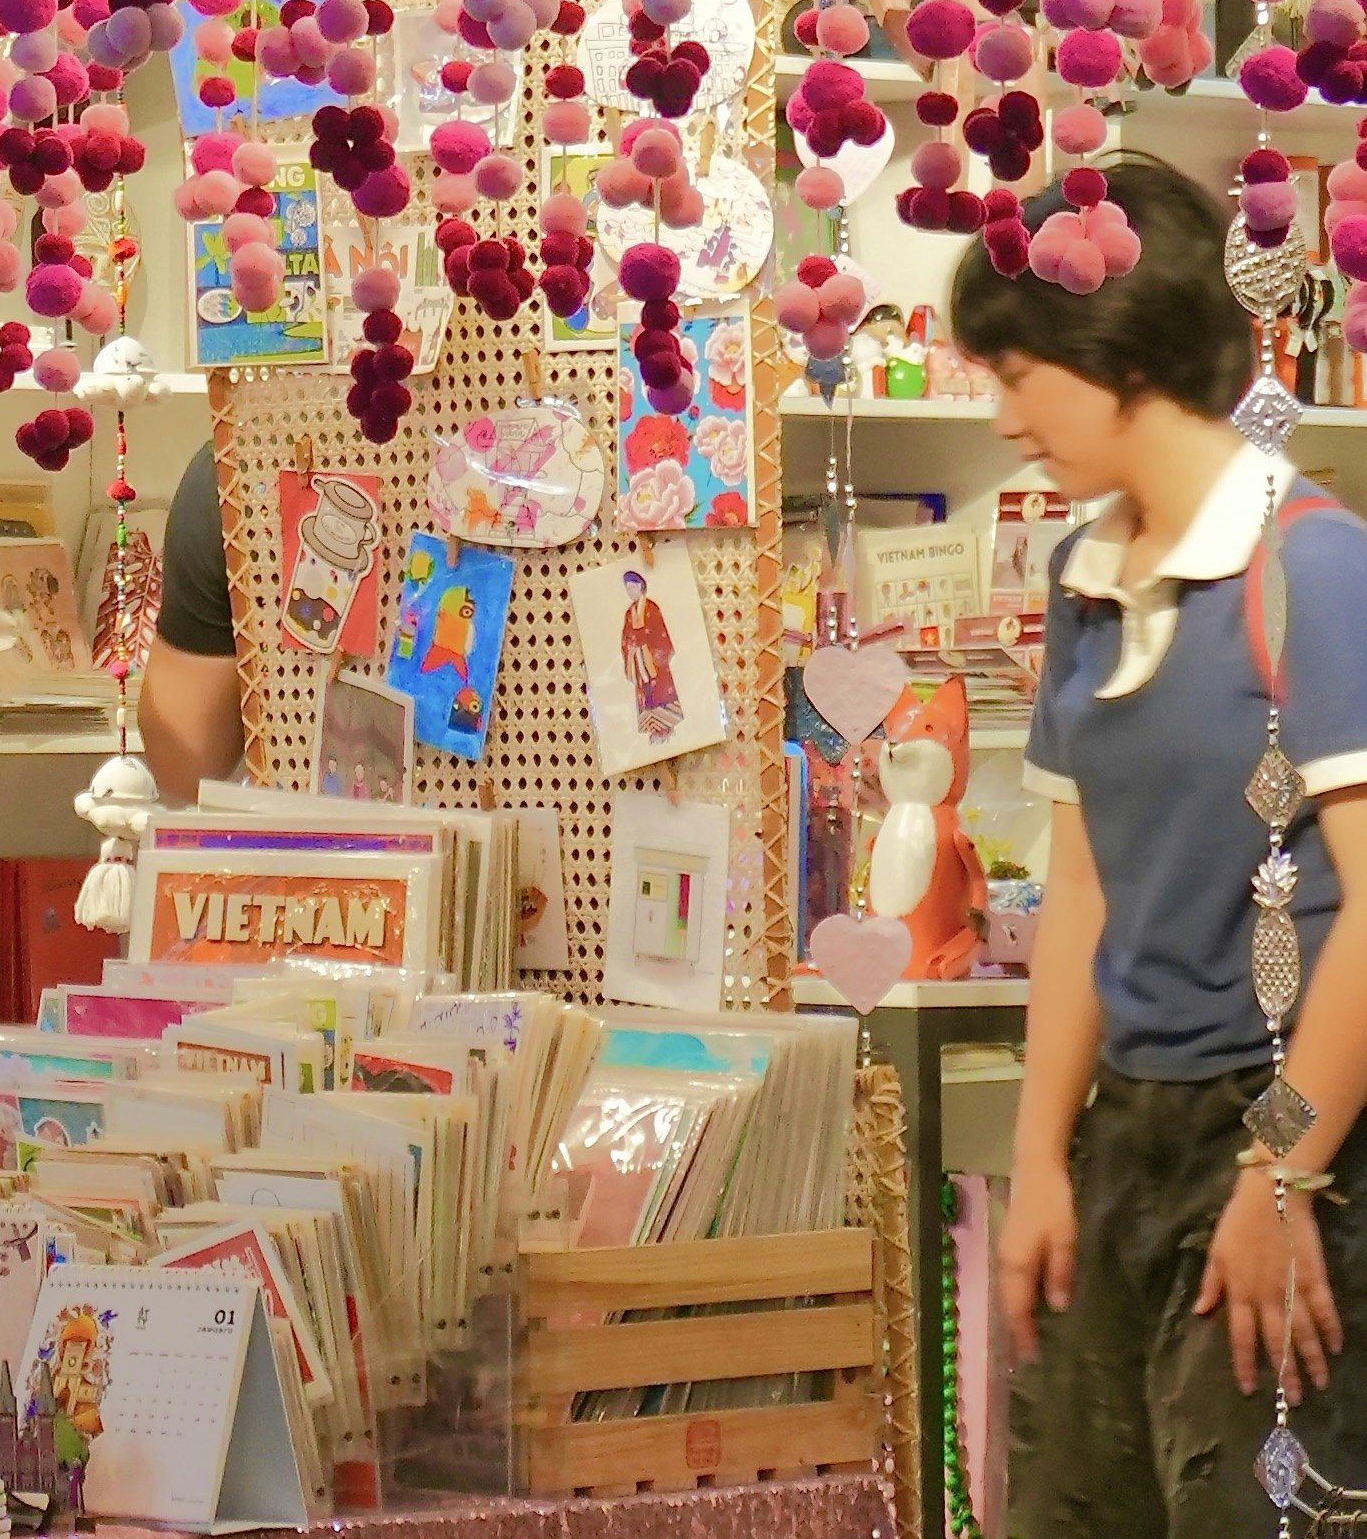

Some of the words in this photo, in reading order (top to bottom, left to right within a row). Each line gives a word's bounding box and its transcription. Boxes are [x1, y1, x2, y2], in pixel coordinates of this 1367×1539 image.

[877, 547, 926, 565] VIETNAM
[928, 542, 965, 559] BINGO
[173, 892, 391, 948] VIETNAM
[214, 1309, 235, 1325] 01
